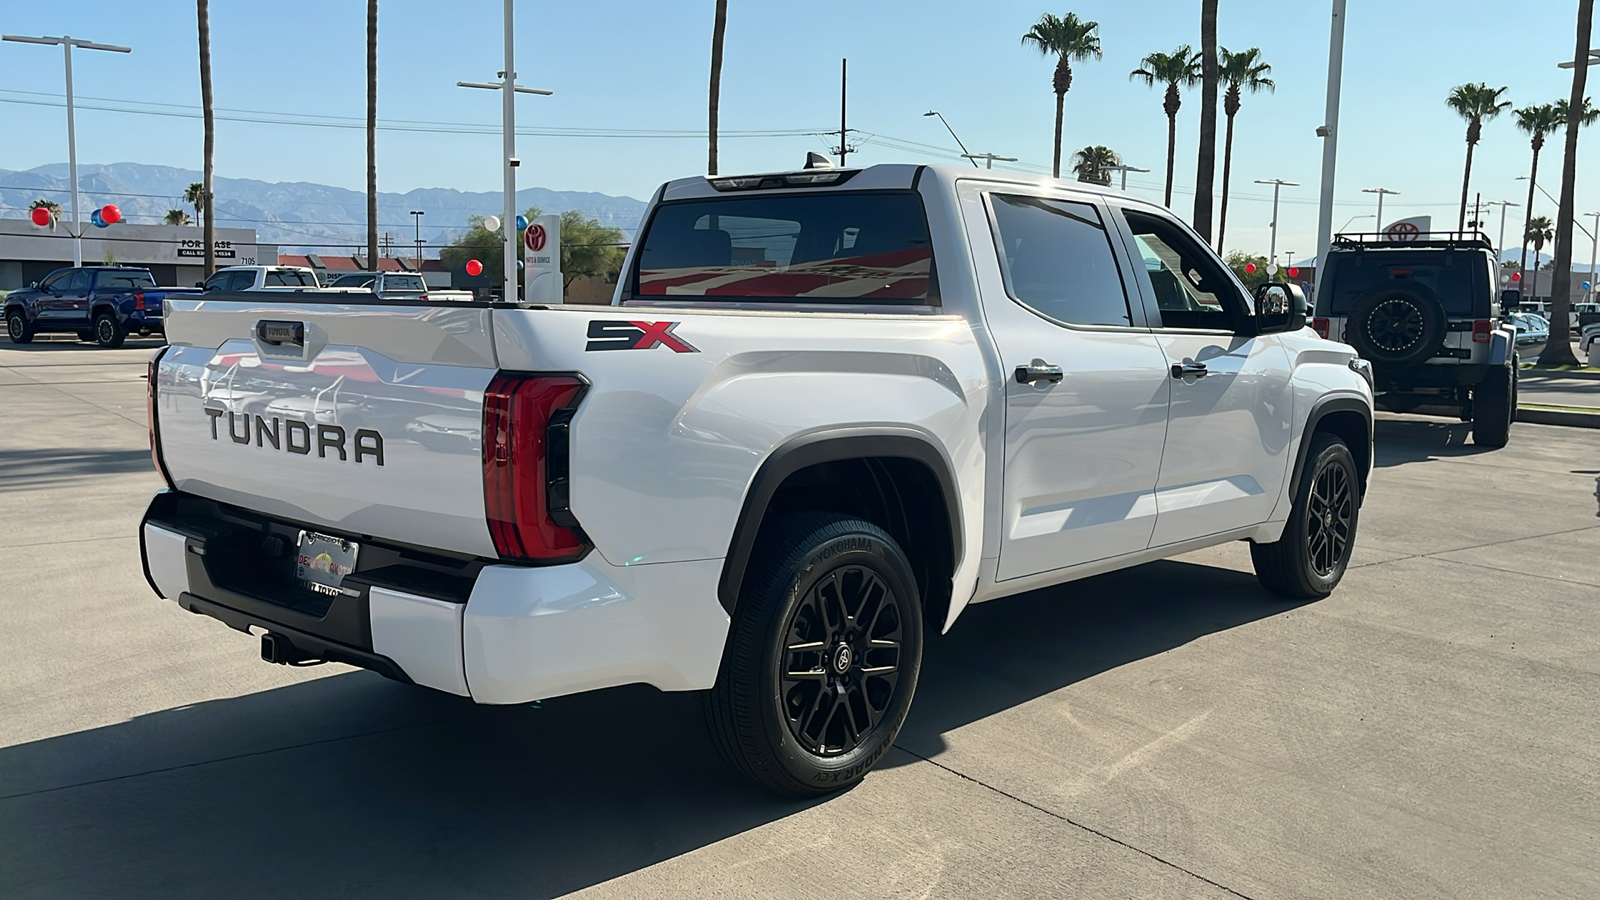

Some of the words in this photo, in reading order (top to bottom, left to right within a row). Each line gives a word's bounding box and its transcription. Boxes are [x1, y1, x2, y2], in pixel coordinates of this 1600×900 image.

[181, 240, 201, 248] FOR
[241, 257, 256, 266] 7105
[267, 326, 290, 337] TOYOTA
[204, 407, 384, 467] TUNDRA
[816, 536, 872, 564] YOKOHAMA
